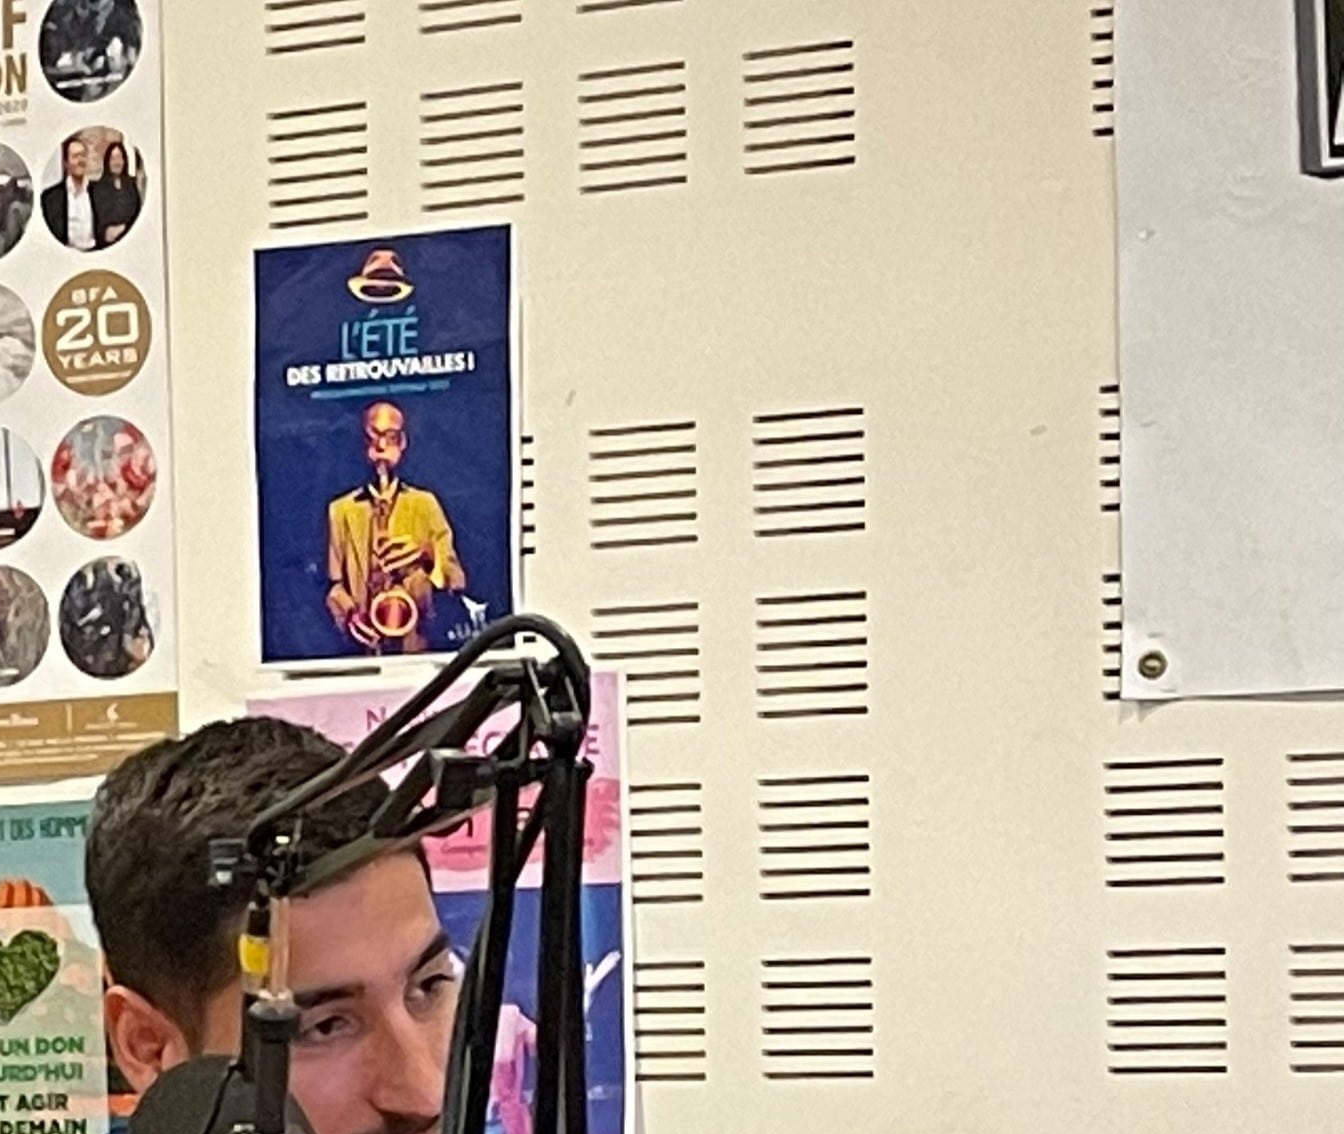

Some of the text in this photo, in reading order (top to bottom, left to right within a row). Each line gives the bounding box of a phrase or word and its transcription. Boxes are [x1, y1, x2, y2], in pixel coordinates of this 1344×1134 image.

[55, 301, 140, 351] 20
[341, 304, 419, 361] L'ÉTÉ
[57, 346, 140, 371] YEARS
[286, 363, 322, 386] DES
[325, 353, 465, 383] RETROUVAILLES
[10, 817, 35, 841] DES
[40, 814, 90, 840] HOMM
[0, 1037, 33, 1057] UN
[36, 1035, 85, 1055] DON
[16, 1093, 69, 1111] AGIR
